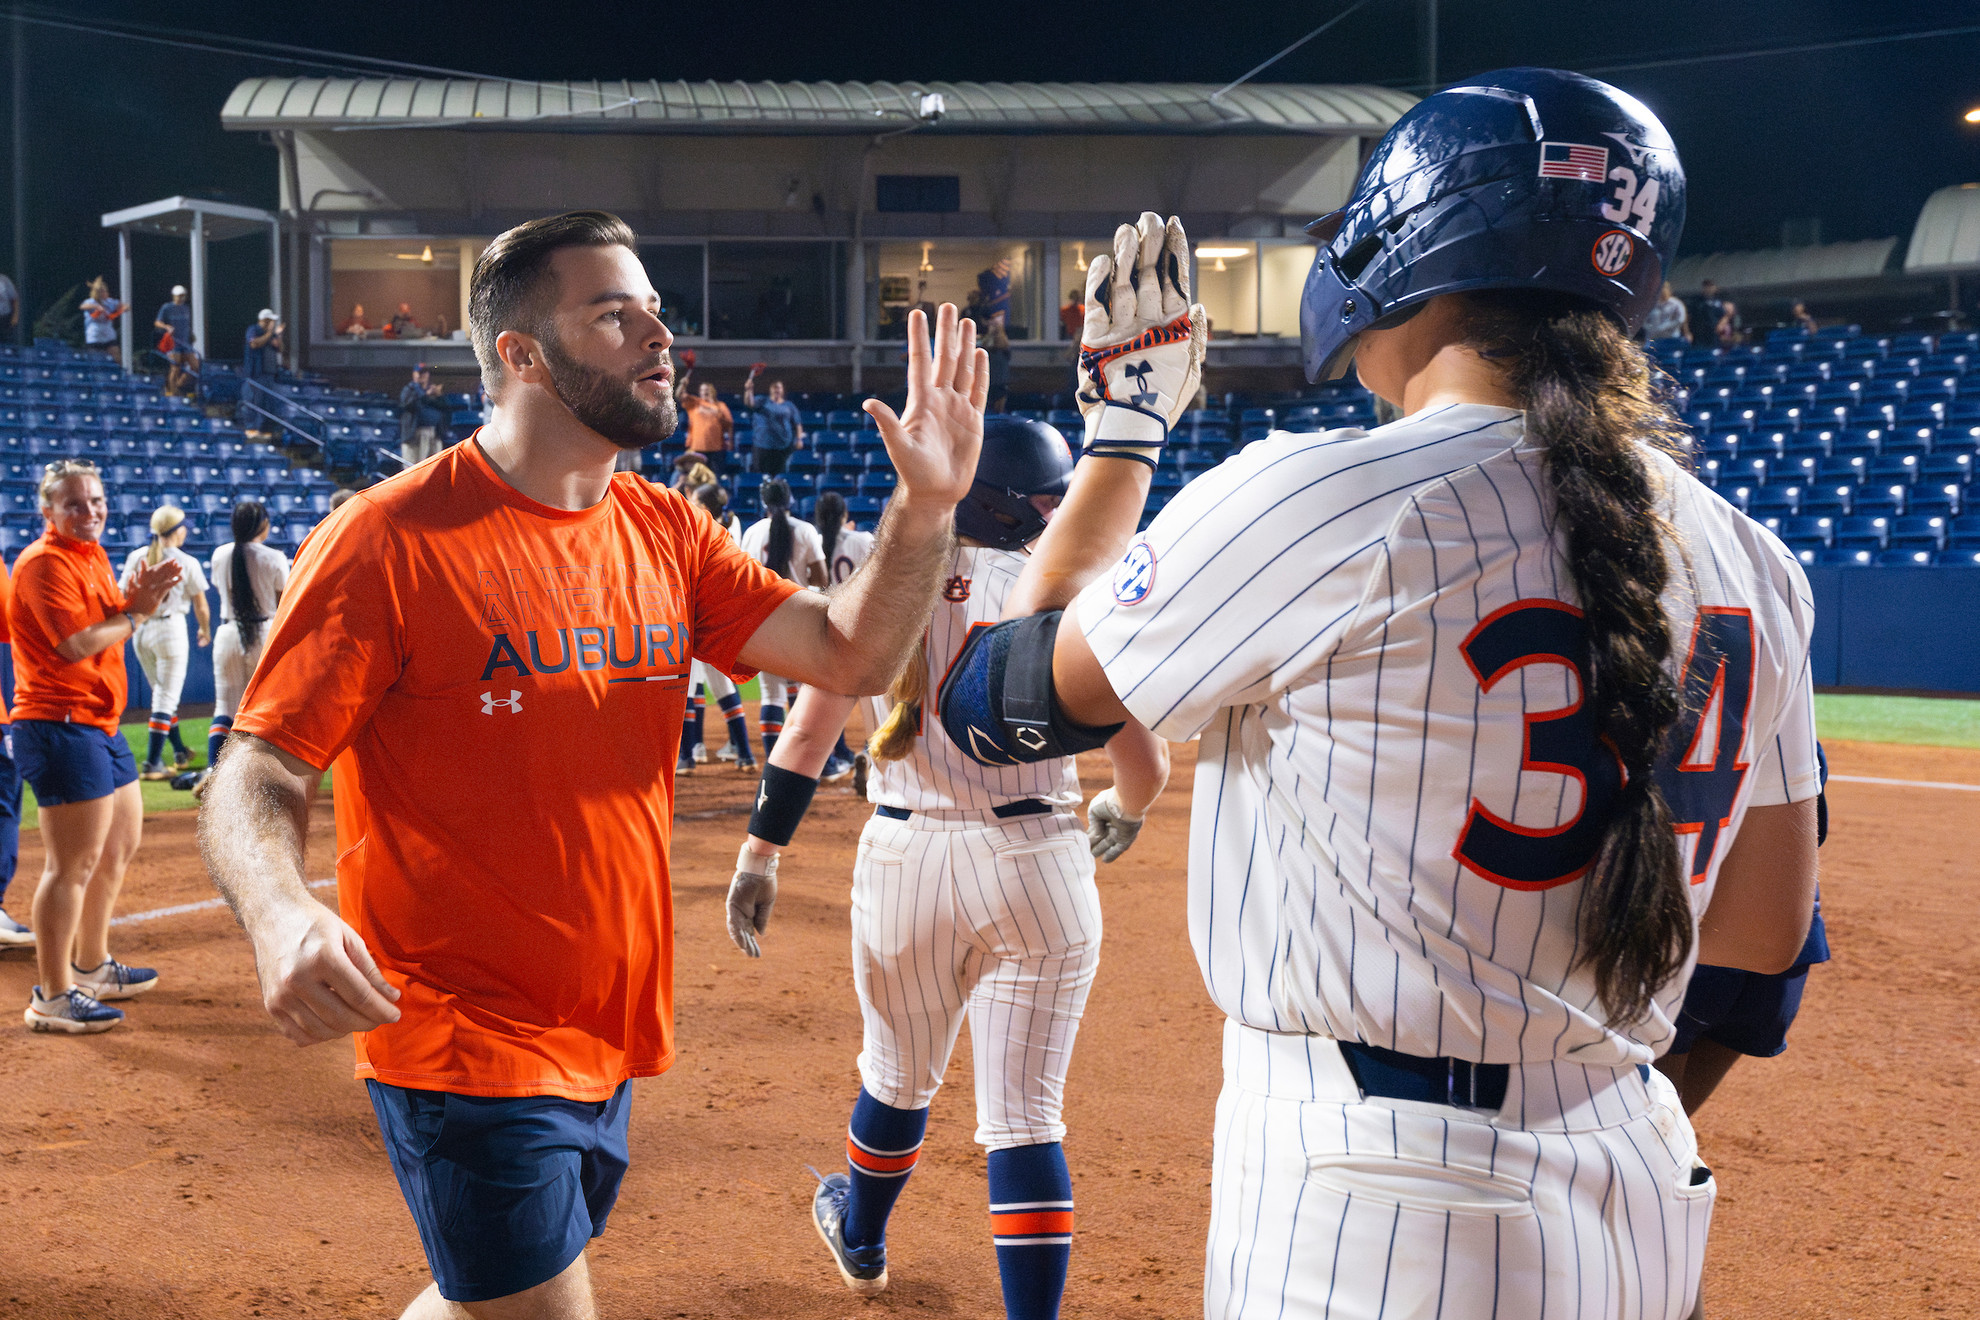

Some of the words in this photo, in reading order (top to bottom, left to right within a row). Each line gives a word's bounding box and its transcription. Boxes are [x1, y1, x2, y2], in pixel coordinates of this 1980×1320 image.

[1601, 166, 1660, 237] 34
[1595, 233, 1632, 273] SEC
[1450, 598, 1756, 892] 34
